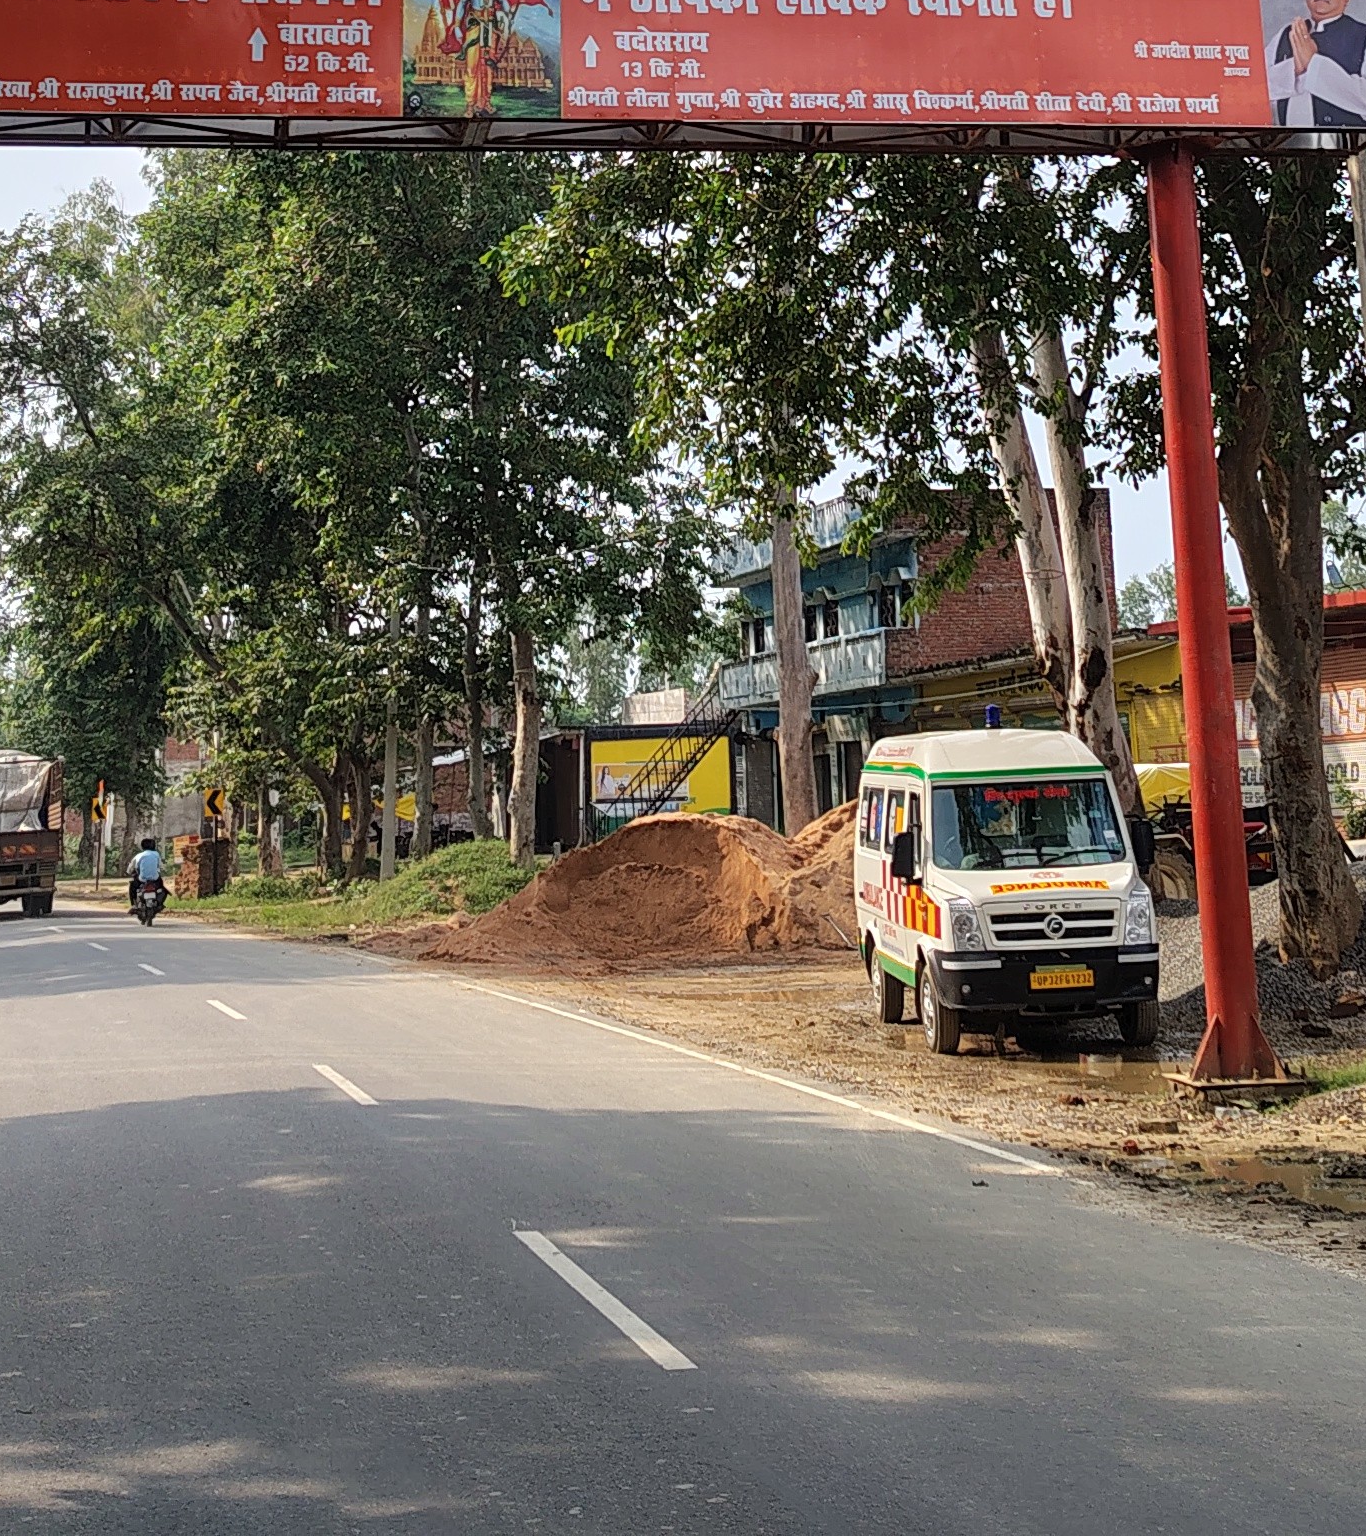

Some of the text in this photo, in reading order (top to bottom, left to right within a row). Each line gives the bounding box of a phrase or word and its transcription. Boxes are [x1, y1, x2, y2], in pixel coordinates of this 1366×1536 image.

[277, 19, 373, 46] बाराबंकी
[613, 26, 709, 53] बदोसराय
[285, 55, 309, 72] 52
[620, 61, 642, 78] 13
[180, 84, 220, 101] सपन
[567, 87, 620, 107] श्रीमती
[624, 88, 670, 107] लीला
[1033, 93, 1072, 112] सीता
[1136, 93, 1181, 113] राजेश
[1184, 94, 1219, 114] शर्मा
[1023, 902, 1083, 910] FORCE
